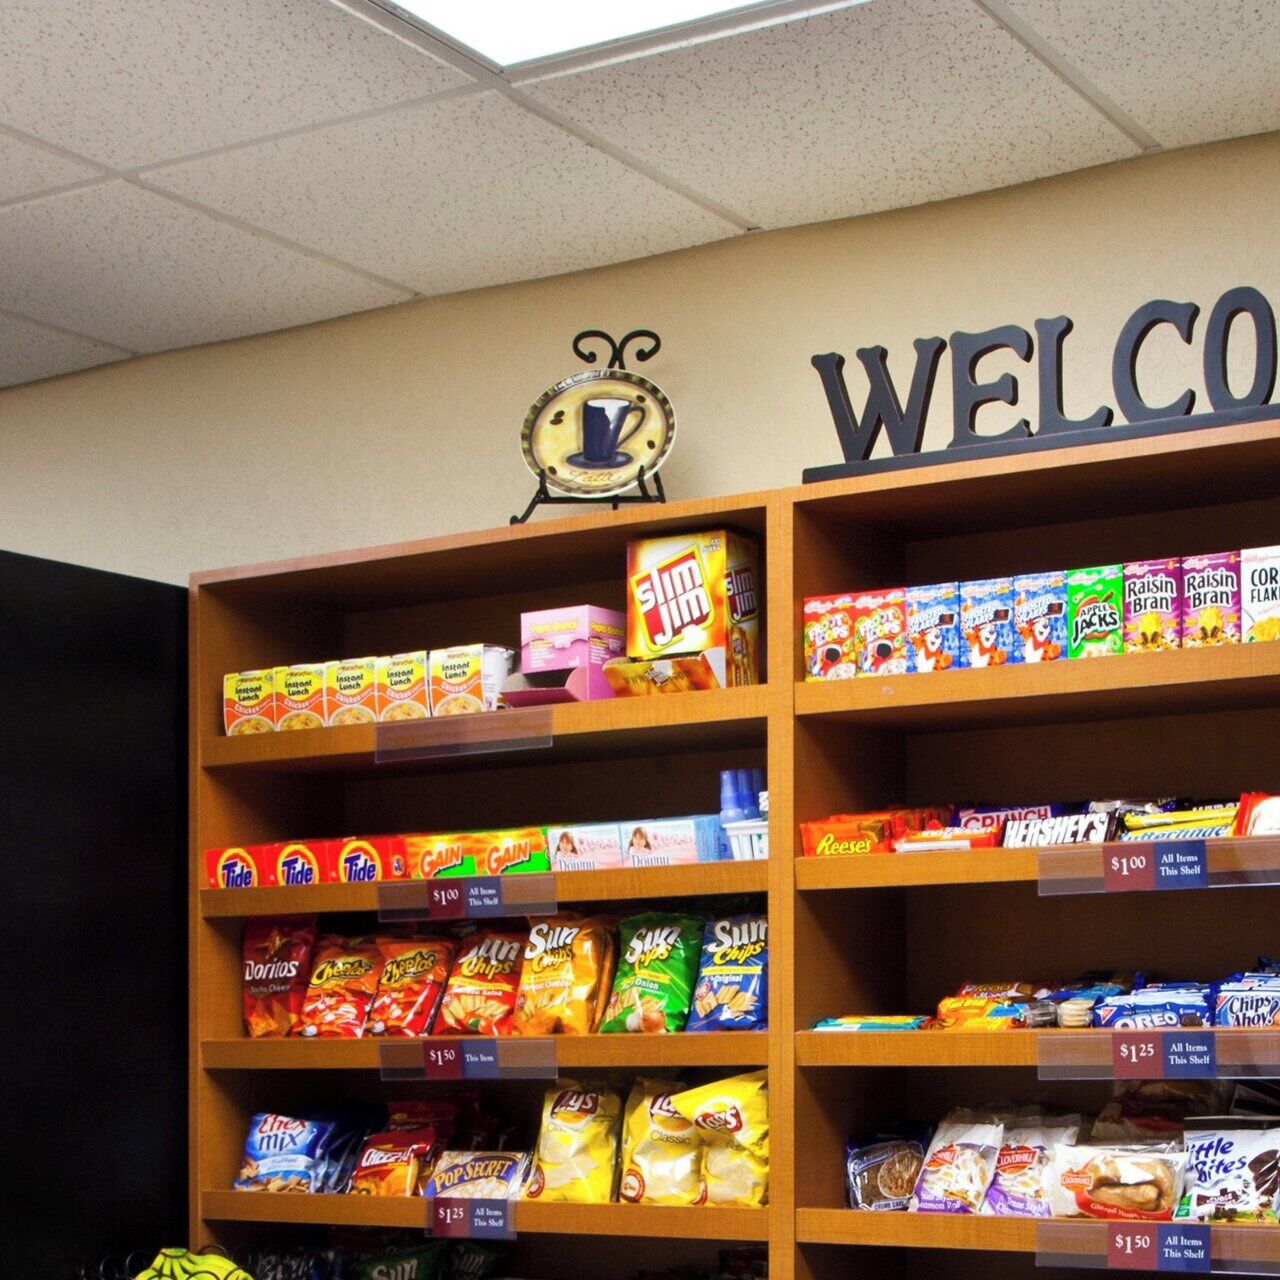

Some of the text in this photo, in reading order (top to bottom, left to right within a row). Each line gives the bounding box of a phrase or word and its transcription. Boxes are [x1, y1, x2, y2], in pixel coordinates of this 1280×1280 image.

[1127, 578, 1177, 598] Raisin
[1186, 571, 1235, 591] Raisin
[1133, 595, 1170, 614] Bran
[1192, 589, 1230, 609] Bran
[1080, 603, 1109, 618] APPLE
[1072, 611, 1118, 644] JACKS
[442, 661, 470, 673] Instant
[445, 668, 467, 680] Lunch
[390, 675, 412, 687] Lunch
[1006, 812, 1108, 848] HERSHEY'S
[816, 832, 872, 857] Reese's
[420, 843, 463, 878] GAIN
[486, 838, 530, 876] GAIN
[1161, 853, 1199, 864] All Items
[282, 856, 313, 885] Tide
[344, 853, 376, 881] Tide
[1160, 865, 1201, 877] This Shelf
[469, 886, 496, 895] All Items
[468, 896, 498, 906] This Shelf
[525, 922, 580, 960] Sun
[709, 919, 768, 953] Sun
[713, 940, 765, 967] Chips
[245, 957, 299, 981] Doritos
[381, 950, 438, 985] Cheetos
[635, 978, 659, 990] Onion
[1114, 1010, 1180, 1028] OREO
[1231, 1001, 1280, 1027] Ahoy!
[1170, 1043, 1208, 1053] All Items
[465, 1053, 480, 1063] This
[481, 1054, 495, 1063] Item
[1168, 1055, 1210, 1066] This Shelf
[258, 1128, 307, 1151] mix
[650, 1129, 692, 1146] Classic
[998, 1152, 1034, 1167] CLOVERHILL
[1195, 1156, 1247, 1183] Bites
[475, 1208, 503, 1217] All Items
[473, 1218, 504, 1228] This Shelf
[1165, 1236, 1203, 1247] All Items
[1163, 1248, 1205, 1260] This Shelf
